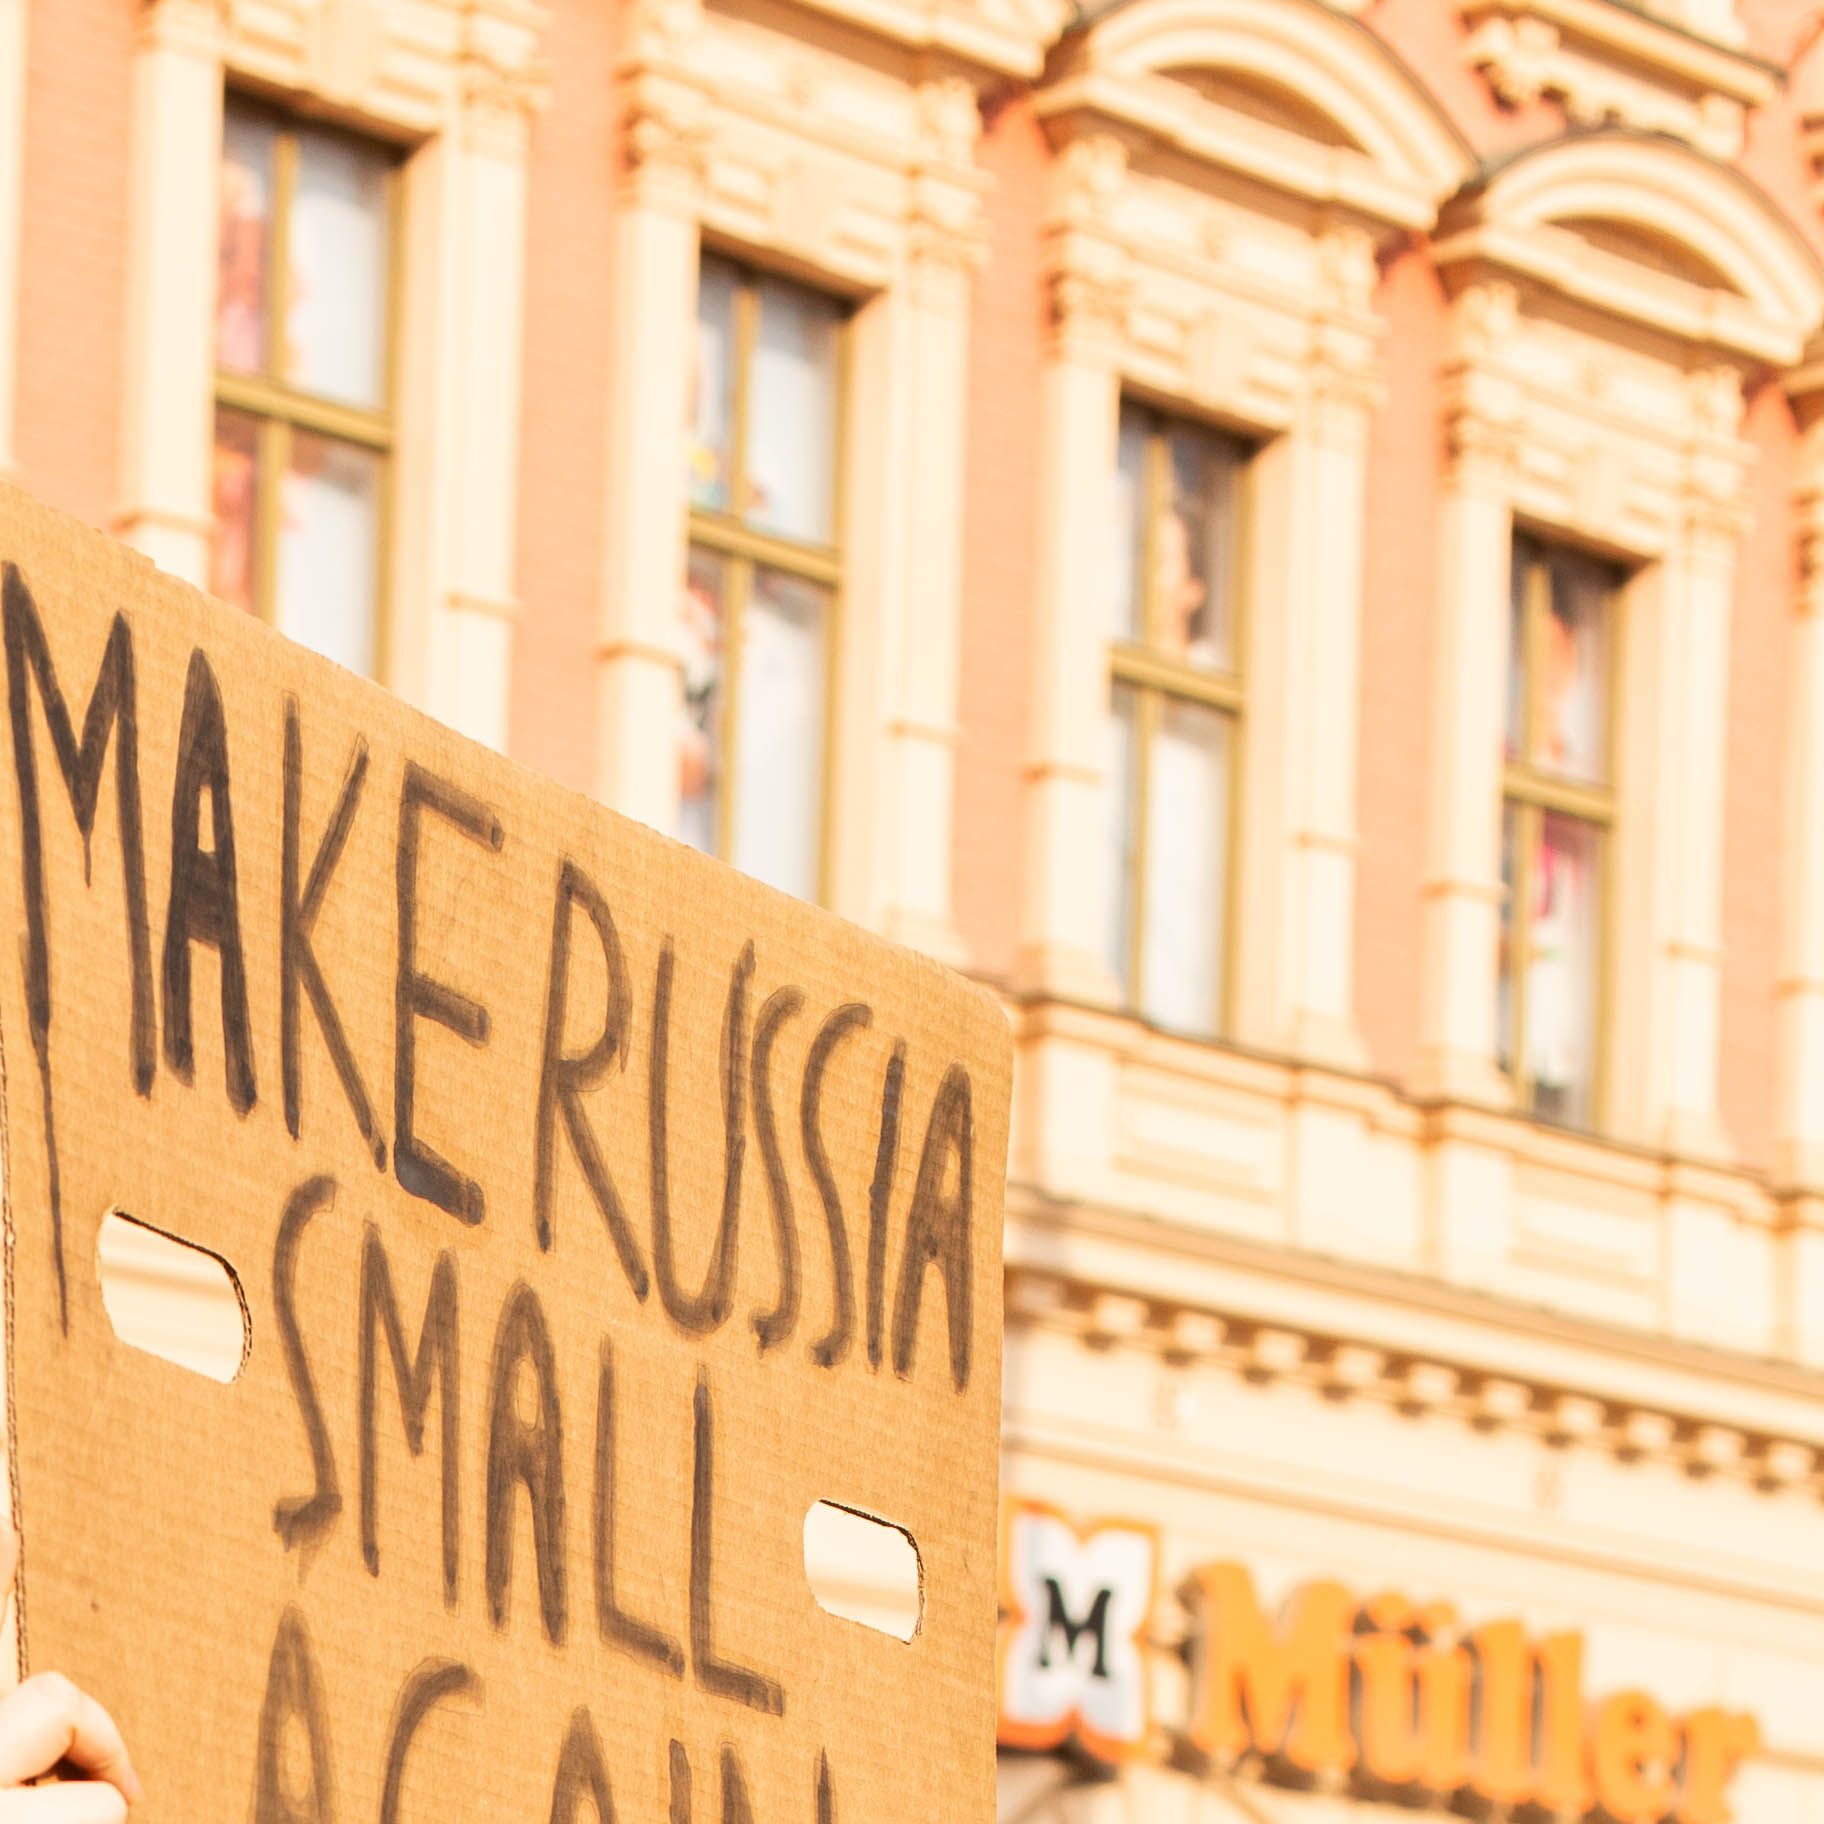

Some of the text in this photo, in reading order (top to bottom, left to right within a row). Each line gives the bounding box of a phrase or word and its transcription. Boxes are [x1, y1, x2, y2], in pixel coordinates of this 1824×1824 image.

[533, 857, 978, 1394] RUSSIA
[271, 1172, 787, 1717] SMALL
[1038, 1576, 1112, 1679] M
